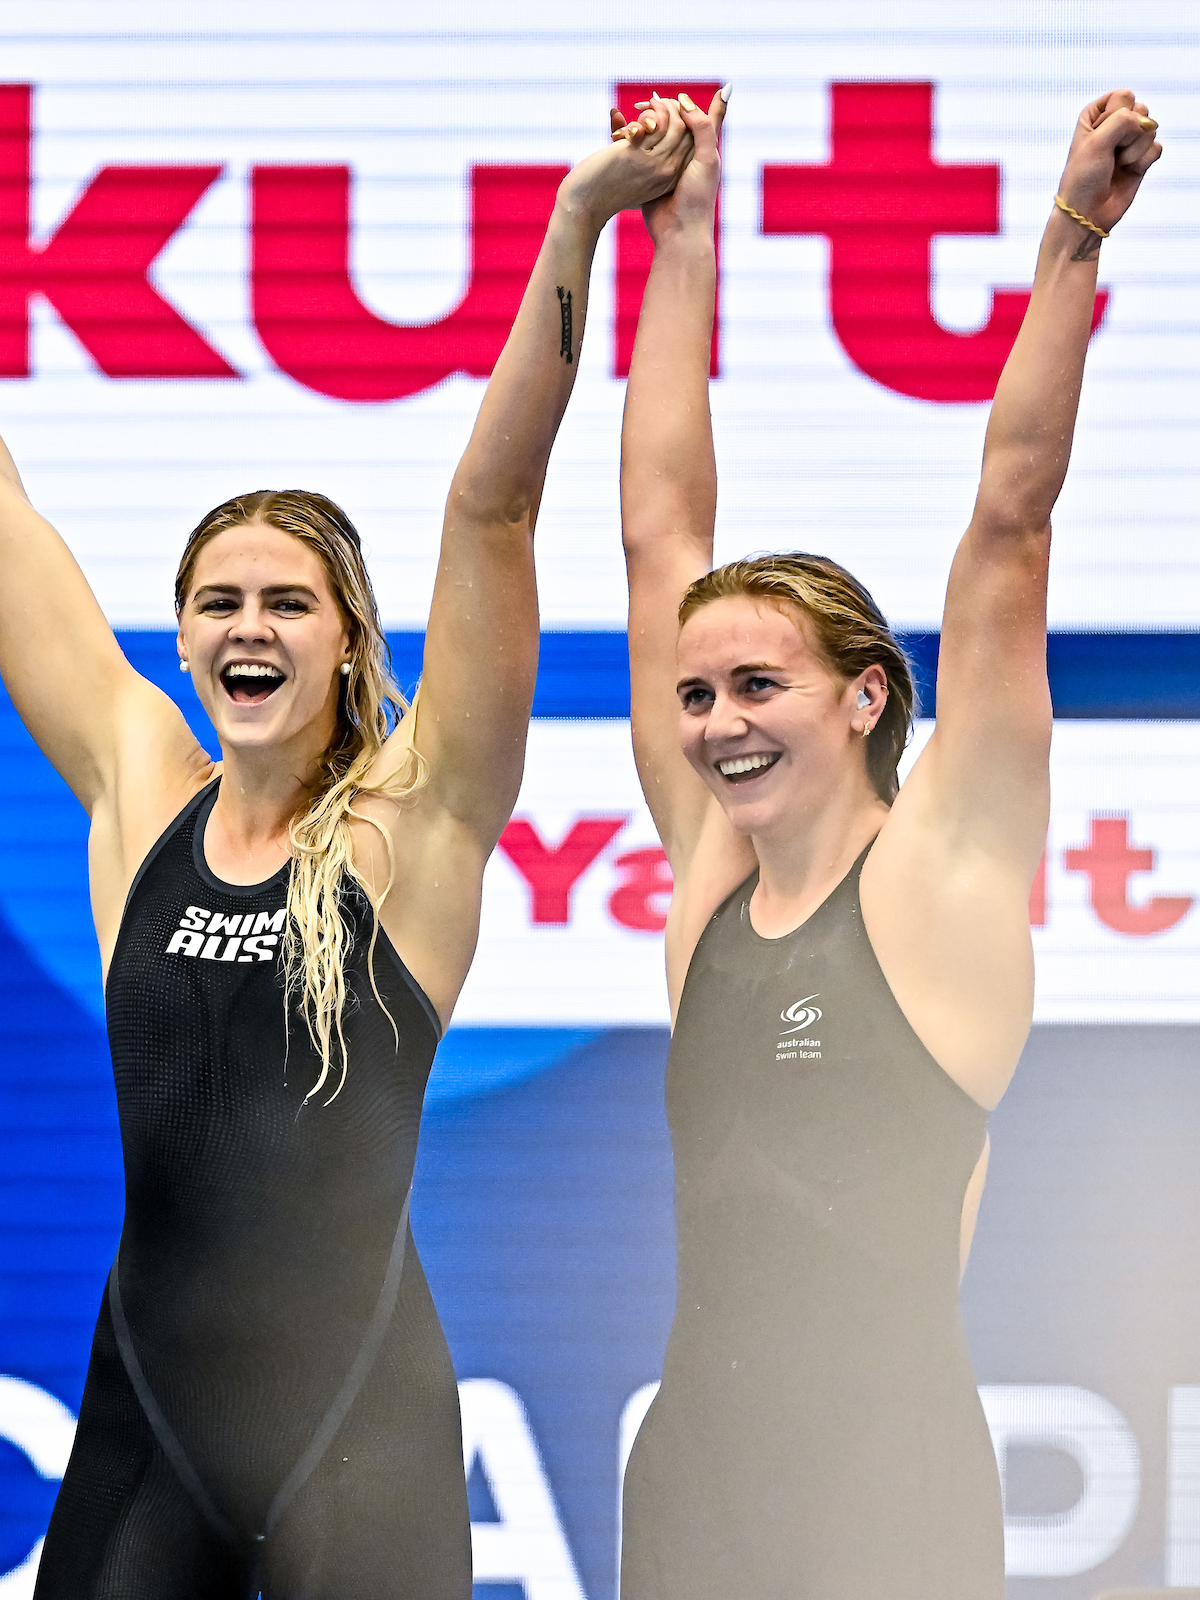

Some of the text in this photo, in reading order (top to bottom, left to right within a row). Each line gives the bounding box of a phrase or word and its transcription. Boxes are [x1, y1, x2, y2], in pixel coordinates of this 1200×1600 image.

[497, 818, 1196, 936] Yat
[179, 905, 287, 936] SWIM
[165, 929, 279, 963] AUS
[775, 1049, 822, 1061] swim team
[776, 1038, 822, 1049] australian
